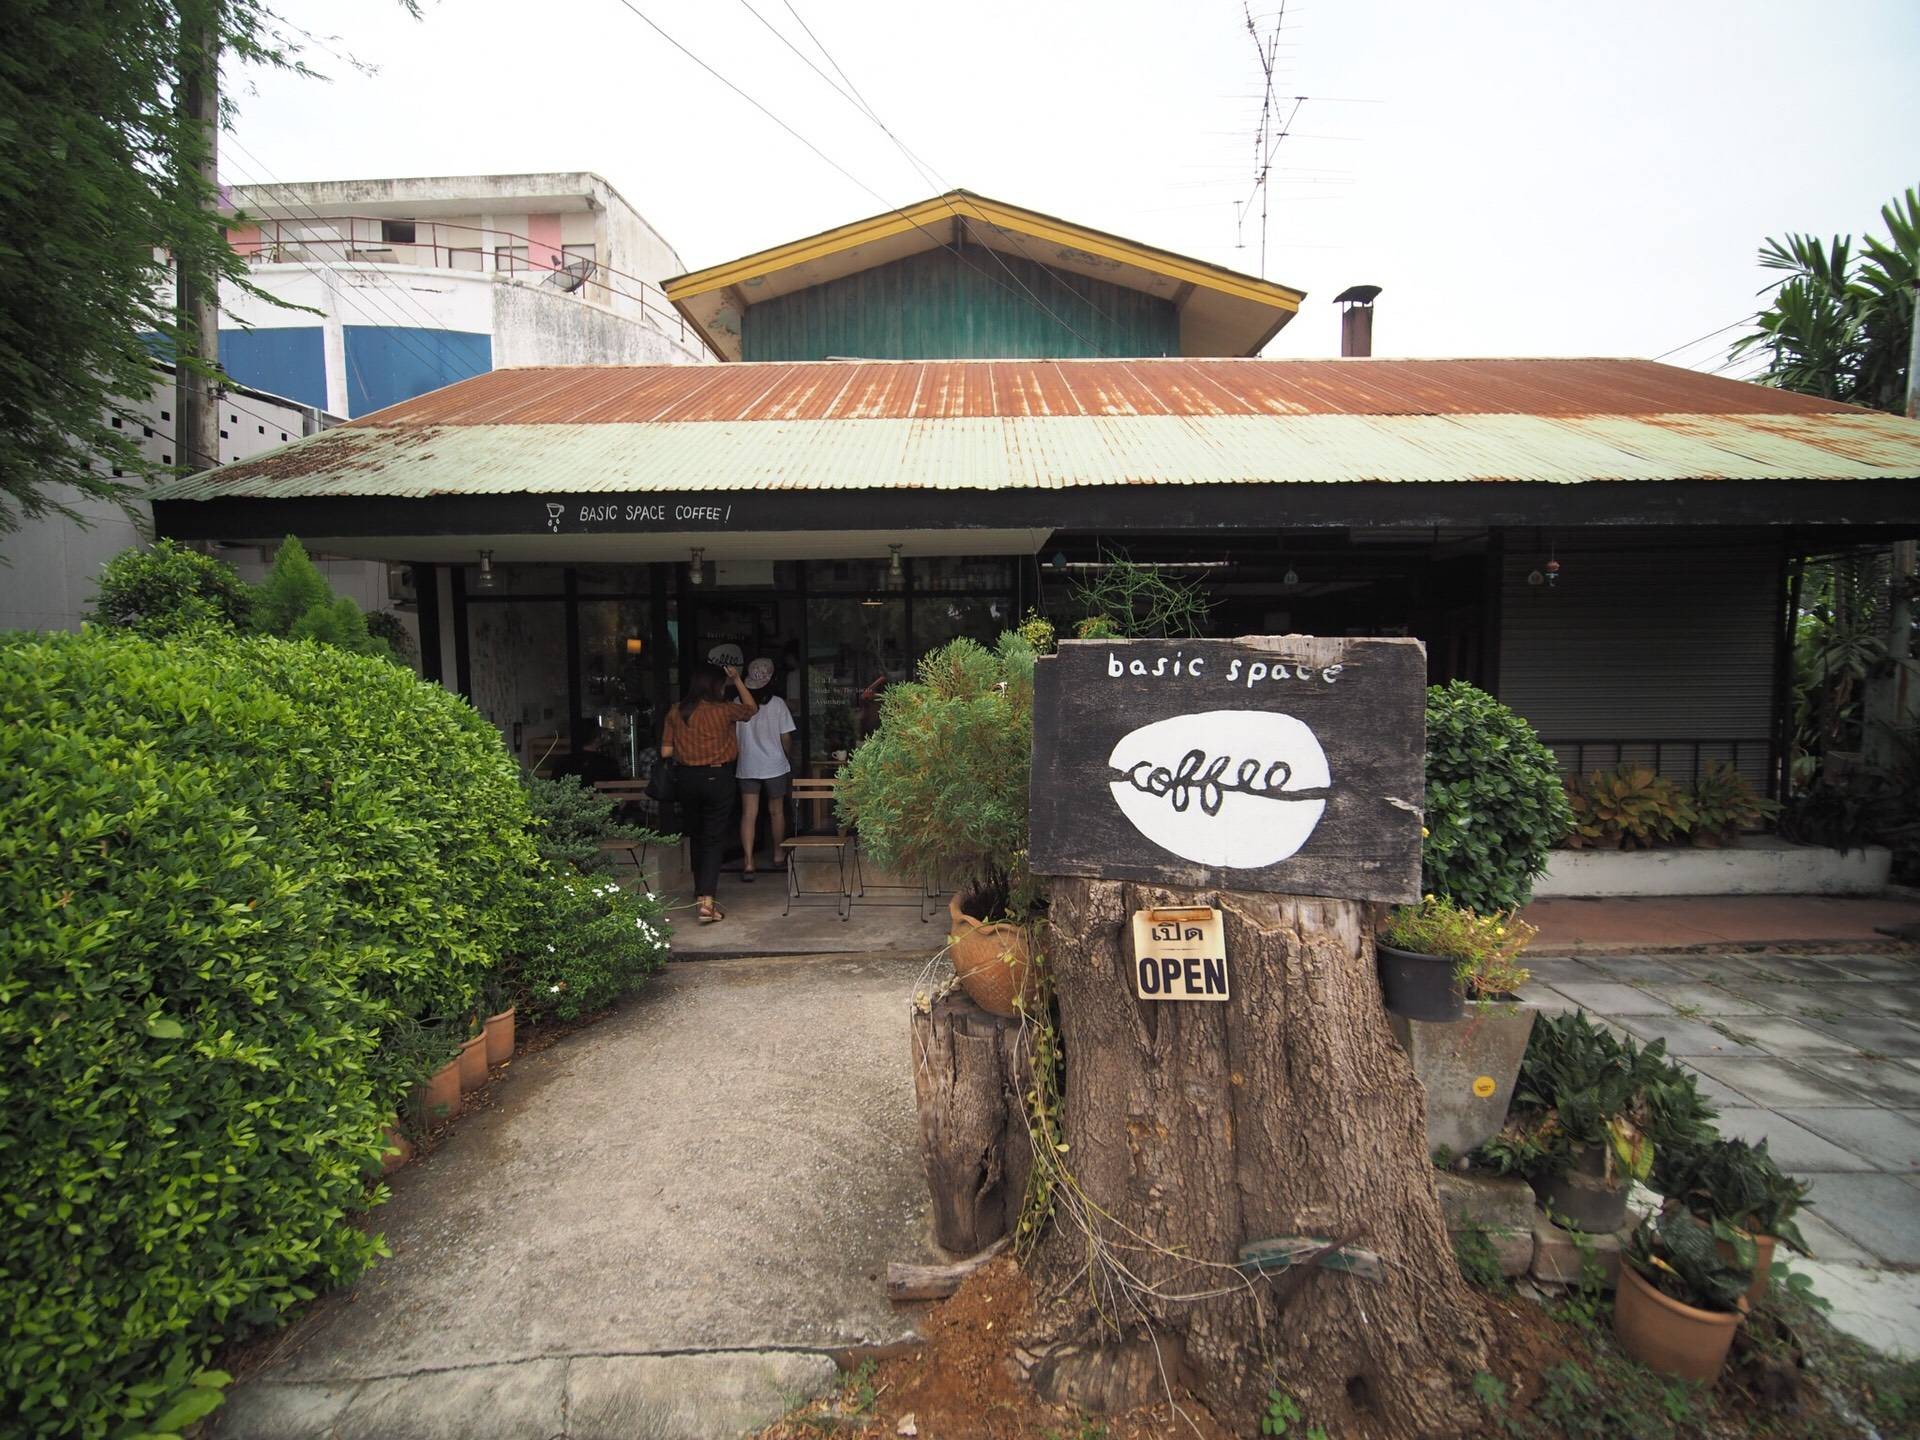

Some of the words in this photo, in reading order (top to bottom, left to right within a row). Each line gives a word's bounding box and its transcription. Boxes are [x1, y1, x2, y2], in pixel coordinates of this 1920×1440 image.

[625, 505, 665, 520] SPACE
[1108, 651, 1204, 678] basic
[1126, 749, 1292, 816] coffee
[1152, 922, 1204, 941] เปิด
[1139, 957, 1227, 995] OPEN
